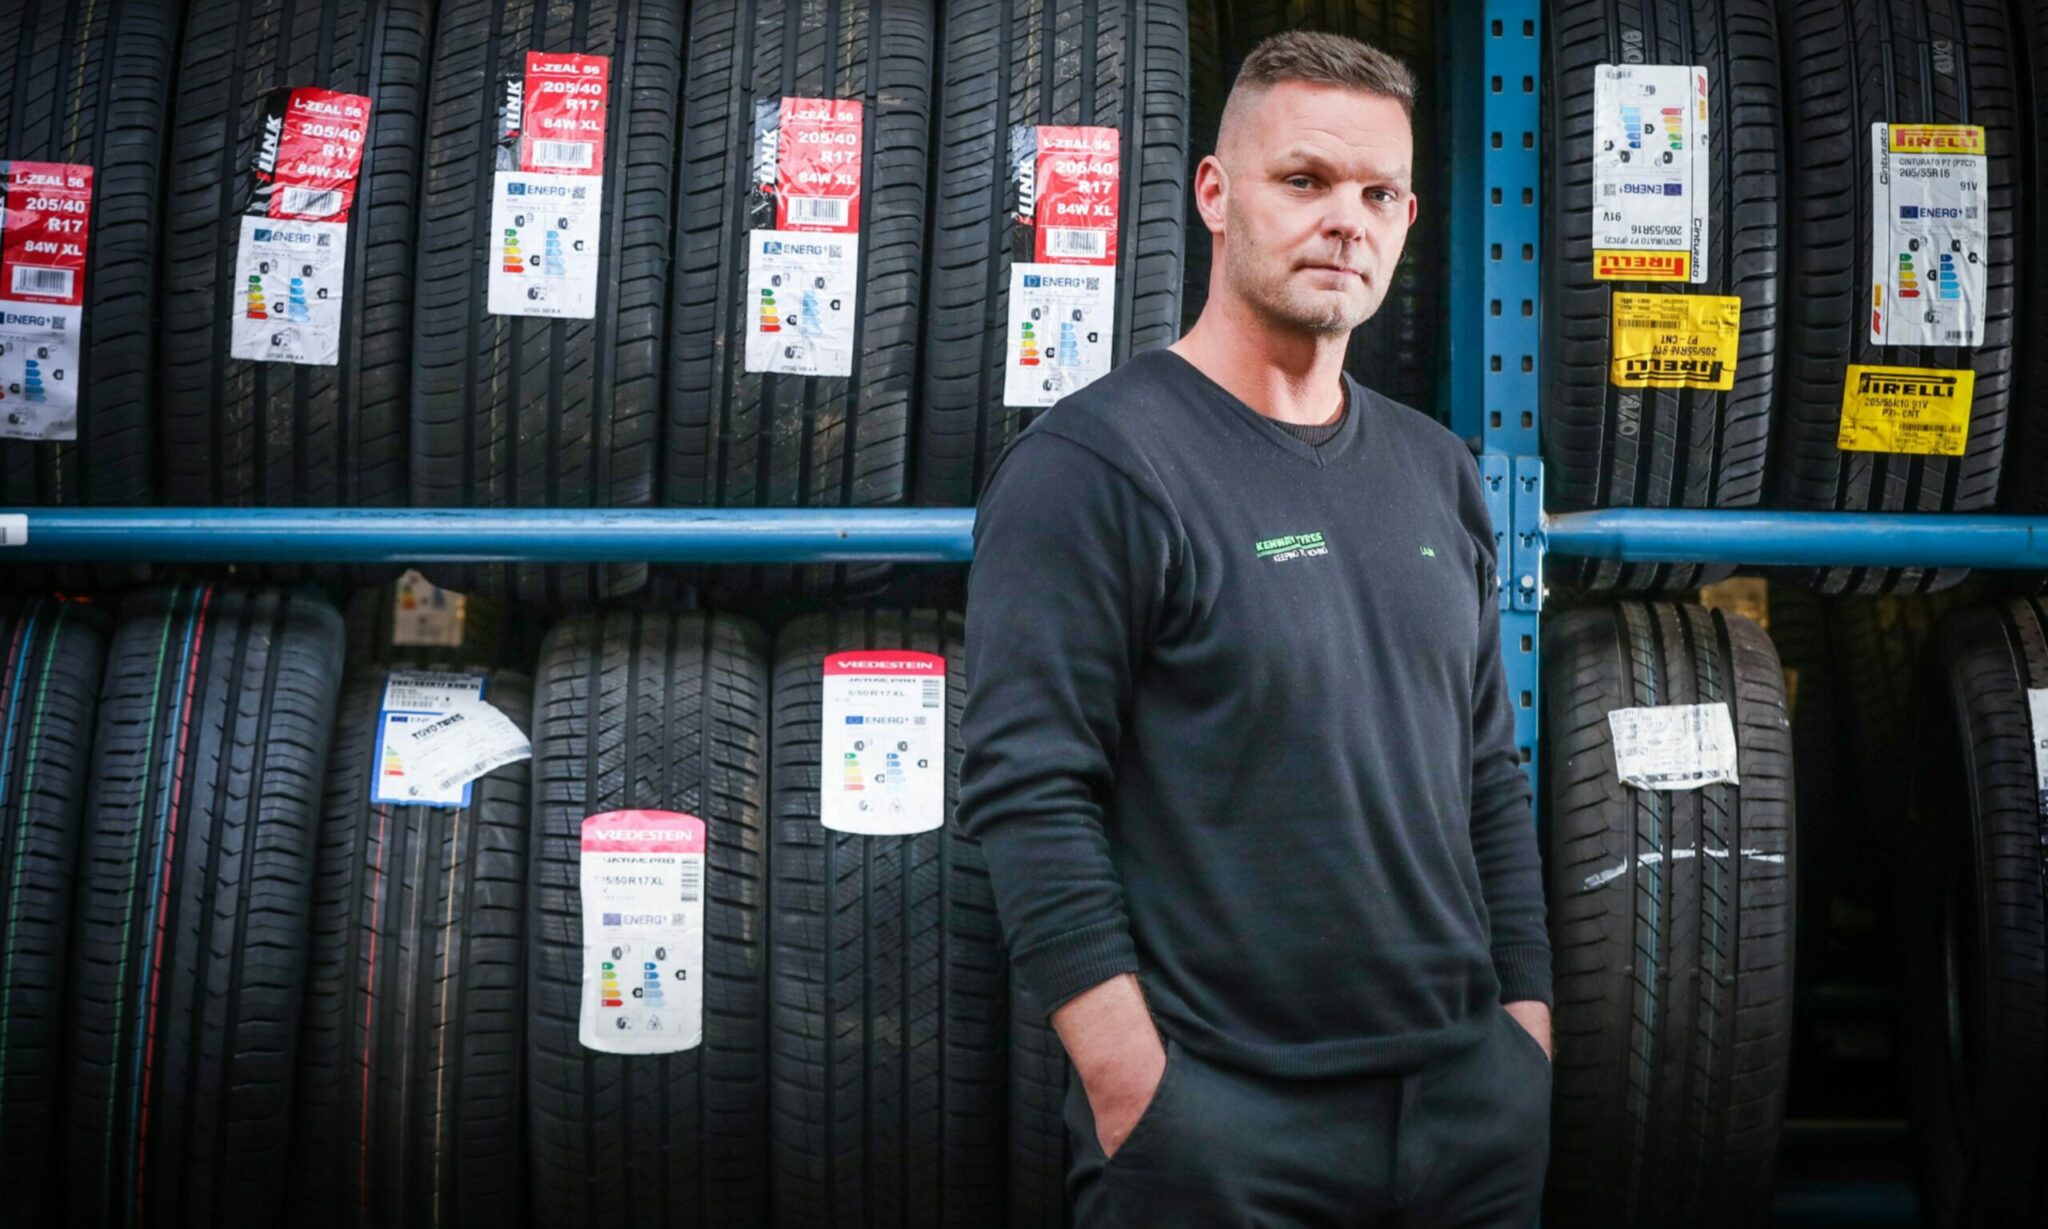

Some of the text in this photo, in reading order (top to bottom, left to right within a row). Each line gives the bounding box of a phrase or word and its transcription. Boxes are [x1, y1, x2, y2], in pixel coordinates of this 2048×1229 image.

[532, 63, 600, 75] L-ZEAL 56
[542, 81, 602, 95] 205/40
[294, 97, 362, 118] L-ZEAL 56
[565, 98, 600, 111] R17
[786, 110, 854, 121] L-ZEAL 56
[543, 118, 601, 131] 84W XL
[301, 123, 361, 142] 205/40
[797, 131, 857, 145] 205/40
[1895, 128, 1978, 148] PIRELLI
[321, 143, 357, 159] R17
[1044, 138, 1111, 151] L-ZEAL 56
[820, 151, 855, 163] R17
[1879, 128, 1889, 186] Cinturato
[1899, 158, 1940, 167] CINTURATO
[1941, 159, 1951, 168] P7
[297, 161, 353, 180] 84W XL
[1055, 160, 1114, 175] 205/40
[1899, 168, 1950, 179] 205/55R16
[15, 173, 85, 188] L-ZEAL 56
[798, 171, 856, 185] 84W XL
[527, 185, 567, 197] ENERG
[1077, 180, 1112, 194] R17
[1623, 183, 1662, 195] ENERG
[1959, 180, 1978, 192] 91V
[25, 196, 86, 214] 205/40
[1057, 203, 1114, 217] 84W XL
[1603, 211, 1622, 222] 91V
[1919, 207, 1958, 219] ENERG
[48, 216, 83, 233] R17
[1631, 224, 1683, 235] 205/55R16
[272, 231, 311, 244] ENERG
[1640, 237, 1683, 246] CINTURATO
[24, 239, 83, 256] 84W XL
[783, 243, 823, 255] ENERG
[1692, 217, 1703, 278] Cinturato
[1600, 255, 1685, 277] PIRELLI
[1042, 276, 1080, 288] ENERG
[6, 313, 45, 327] ENERG
[1660, 334, 1678, 345] CNT
[1625, 359, 1723, 384] PIRELLI
[1858, 372, 1958, 398] PIRELLI
[1255, 531, 1323, 552] KENWAY TYRES
[837, 661, 933, 670] VREDESTEIN
[594, 829, 693, 842] VREDESTEIN
[638, 876, 649, 886] 17
[651, 876, 664, 886] XL
[622, 914, 662, 925] ENERG
